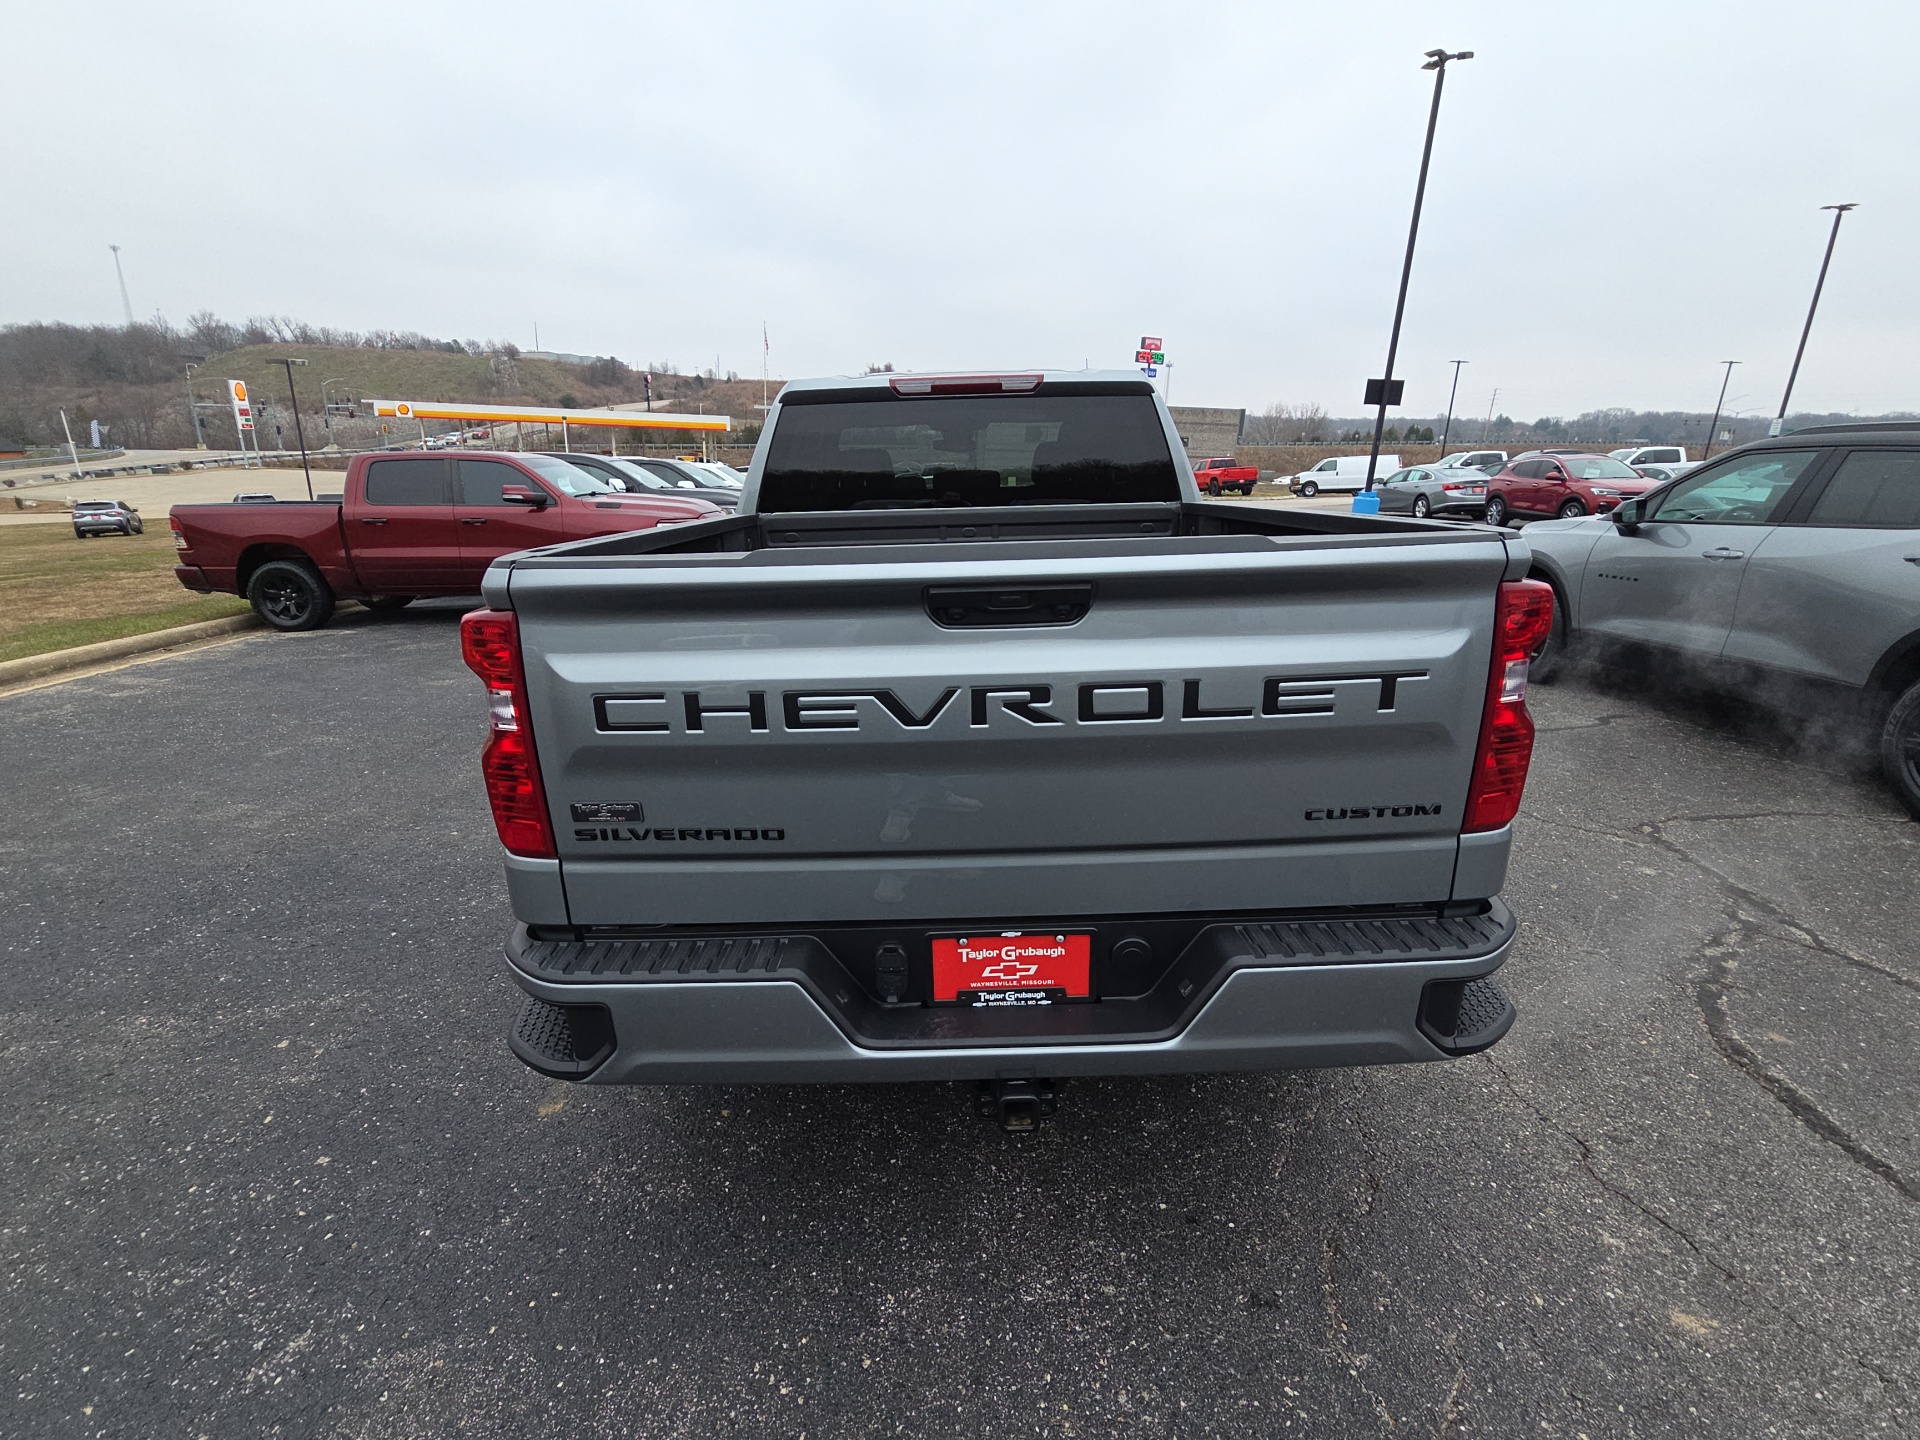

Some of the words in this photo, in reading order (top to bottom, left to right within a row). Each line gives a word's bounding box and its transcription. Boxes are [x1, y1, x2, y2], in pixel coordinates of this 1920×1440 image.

[590, 668, 1430, 734] CHEVROLET
[1304, 802, 1442, 821] CUSTOM
[574, 827, 785, 842] SILVERADO
[957, 948, 999, 963] Taylor
[1001, 945, 1066, 960] Grubaugh
[970, 980, 1020, 988] WAYNESVILLE,
[978, 992, 1005, 1002] Taylor
[1005, 991, 1046, 1001] Grubaugh
